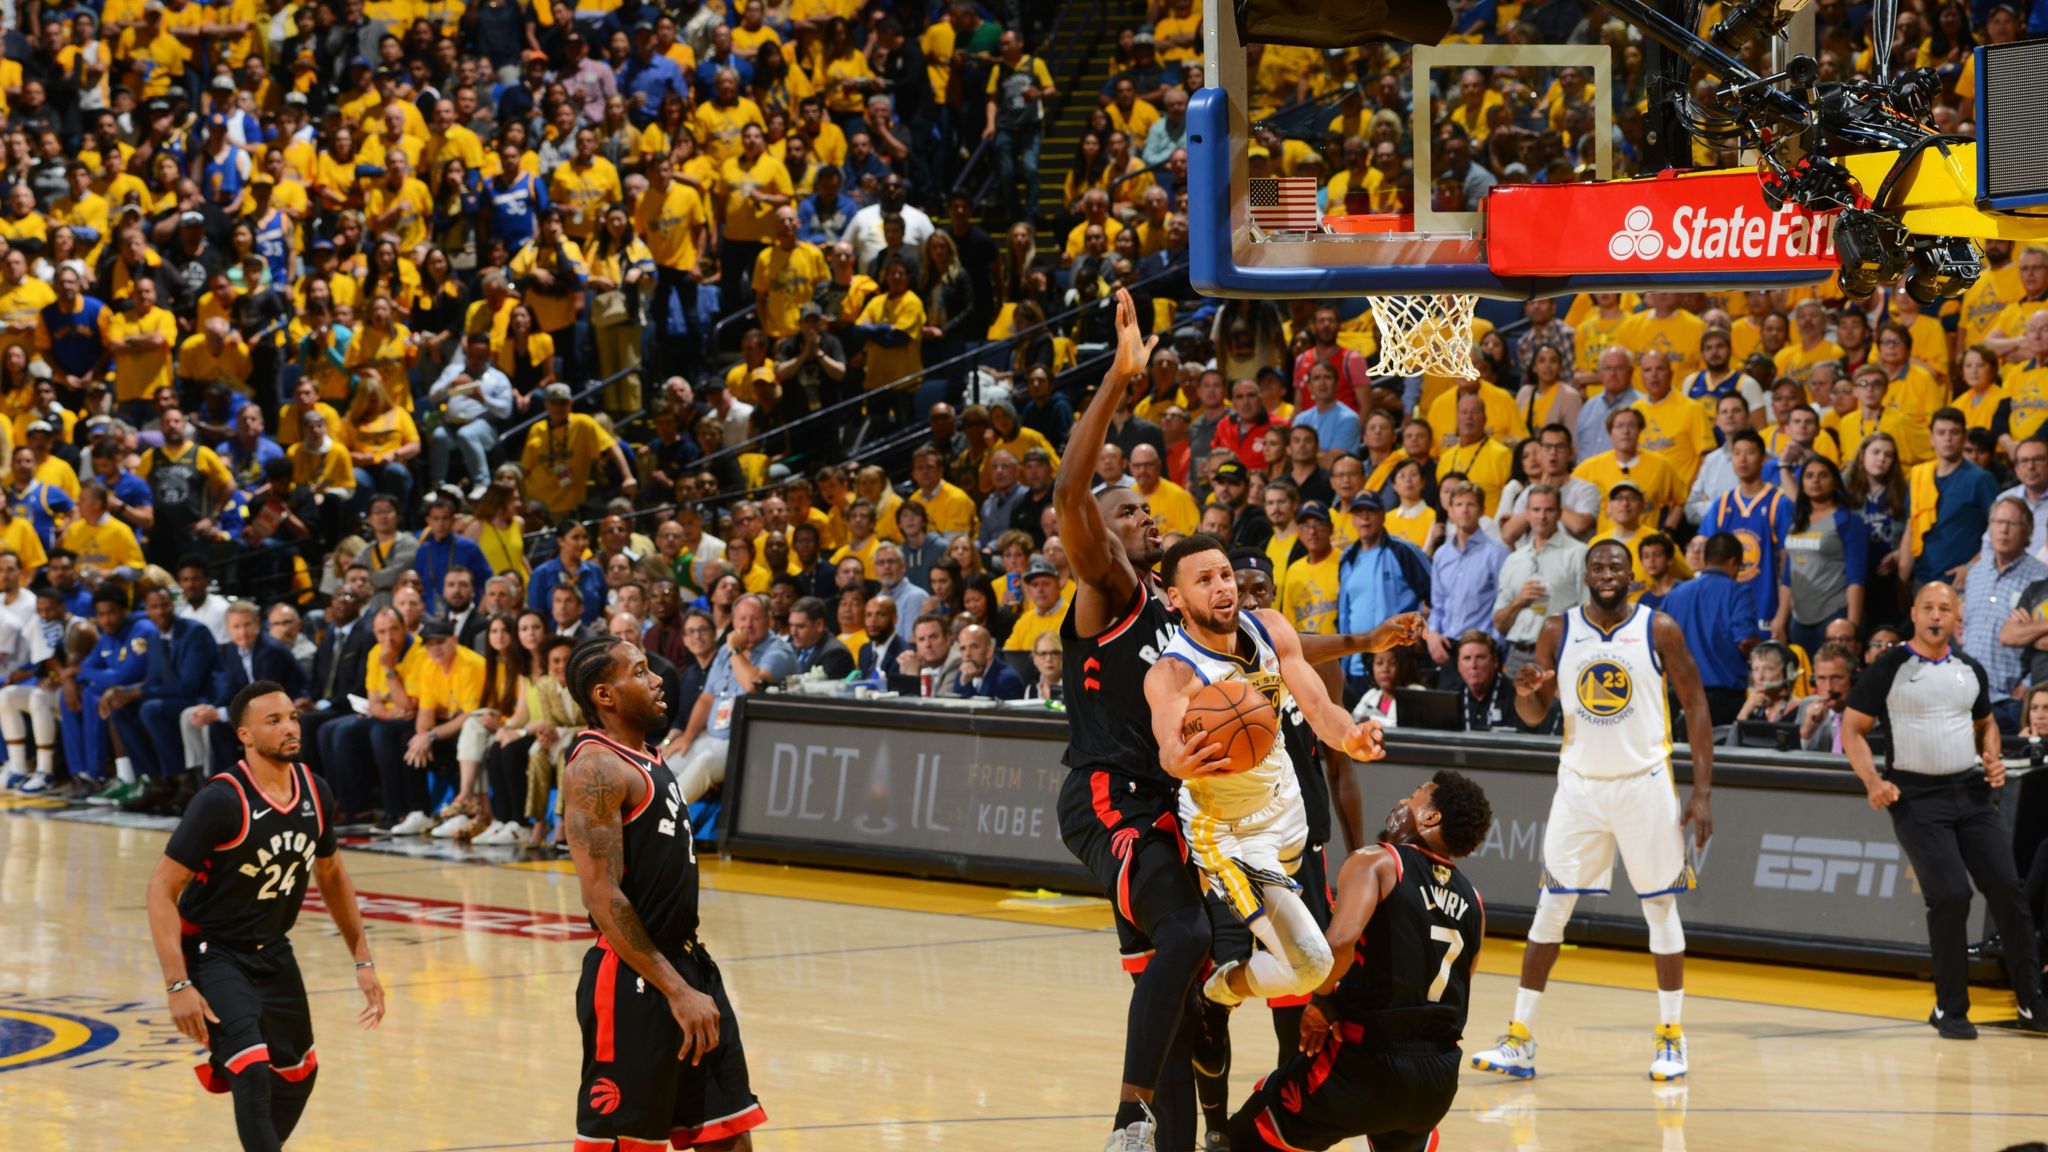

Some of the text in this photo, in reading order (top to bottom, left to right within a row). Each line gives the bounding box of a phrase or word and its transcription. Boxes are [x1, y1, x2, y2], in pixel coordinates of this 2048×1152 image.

[1603, 671, 1626, 688] 23
[1576, 706, 1634, 725] WARRIORS
[967, 763, 1023, 791] FROM
[977, 803, 1043, 838] KOBE
[256, 861, 301, 900] 24
[1419, 885, 1470, 921] LWRY
[1427, 924, 1465, 1003] 7
